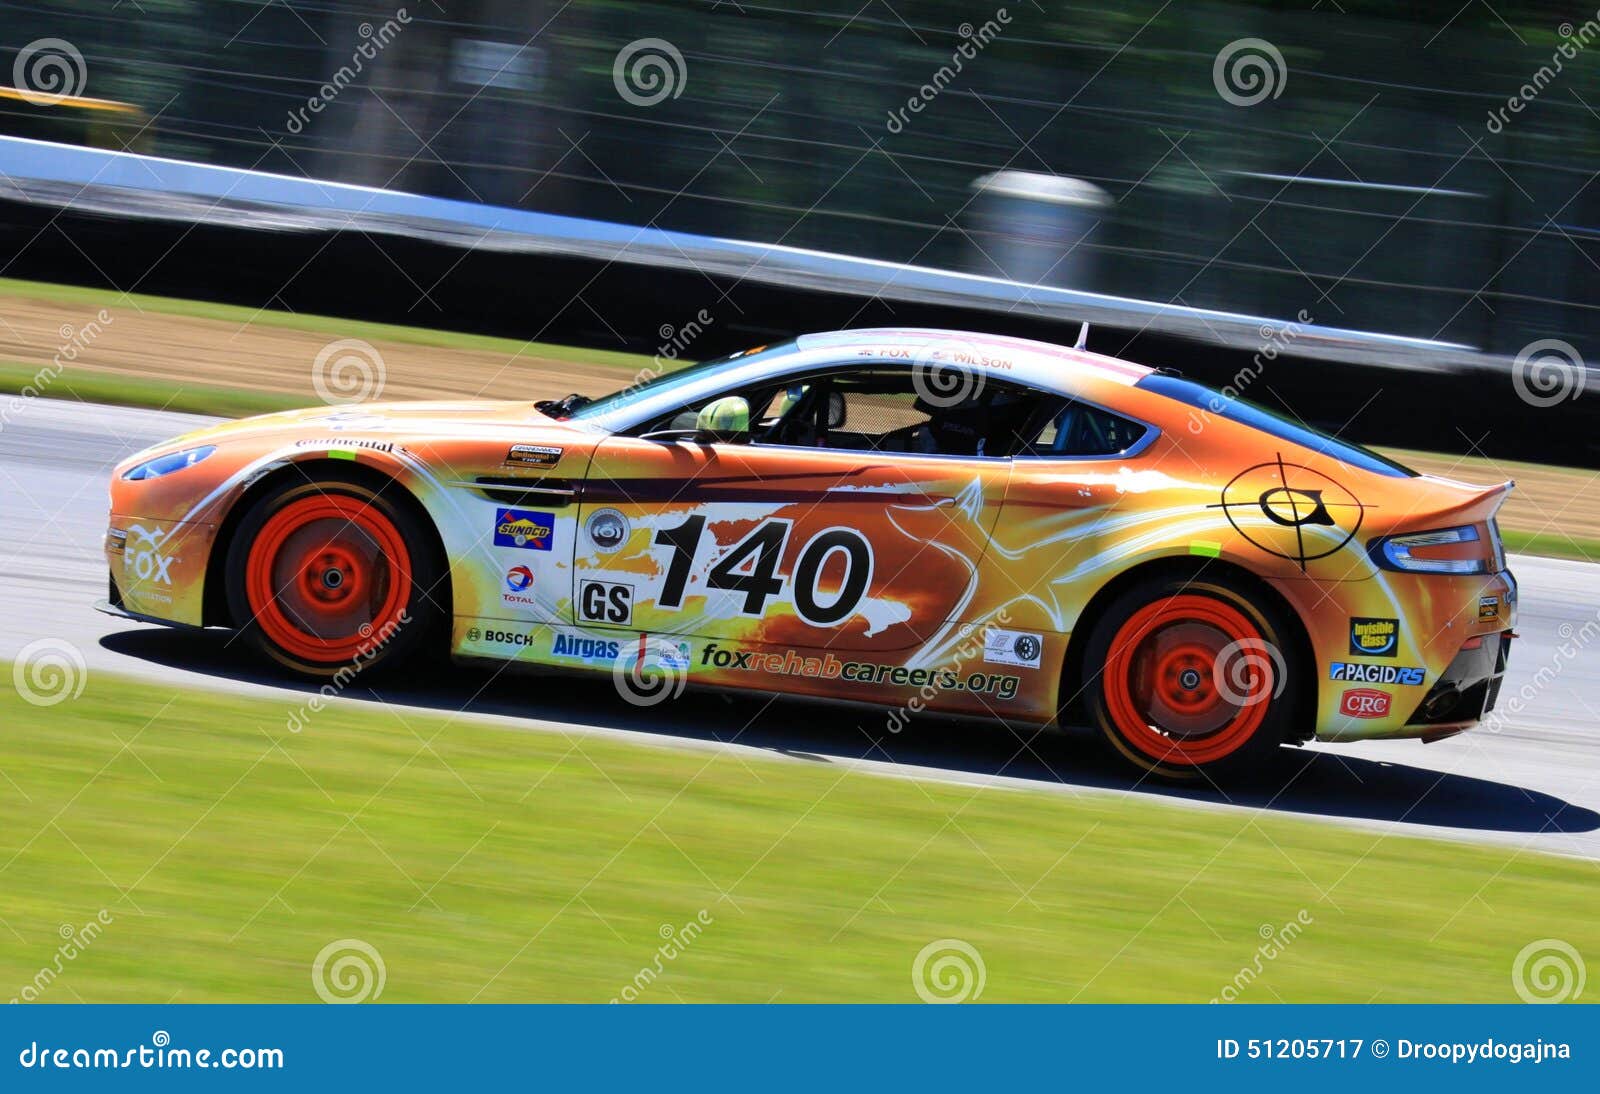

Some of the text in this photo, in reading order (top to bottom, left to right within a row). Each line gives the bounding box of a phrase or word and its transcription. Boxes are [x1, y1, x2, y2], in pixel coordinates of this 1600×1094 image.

[879, 349, 911, 358] FOX
[953, 352, 1013, 370] WILSON
[499, 523, 549, 538] SUNOCO
[124, 546, 174, 586] FOX
[654, 513, 871, 625] 140
[503, 593, 534, 604] TOTAL
[582, 582, 630, 623] GS
[1355, 621, 1394, 636] Invisible
[485, 629, 534, 647] BOSCH
[552, 634, 619, 659] Airgas
[1361, 634, 1387, 648] Glass
[701, 643, 1020, 699] foxrehabcareers.org
[1346, 695, 1387, 713] CRC
